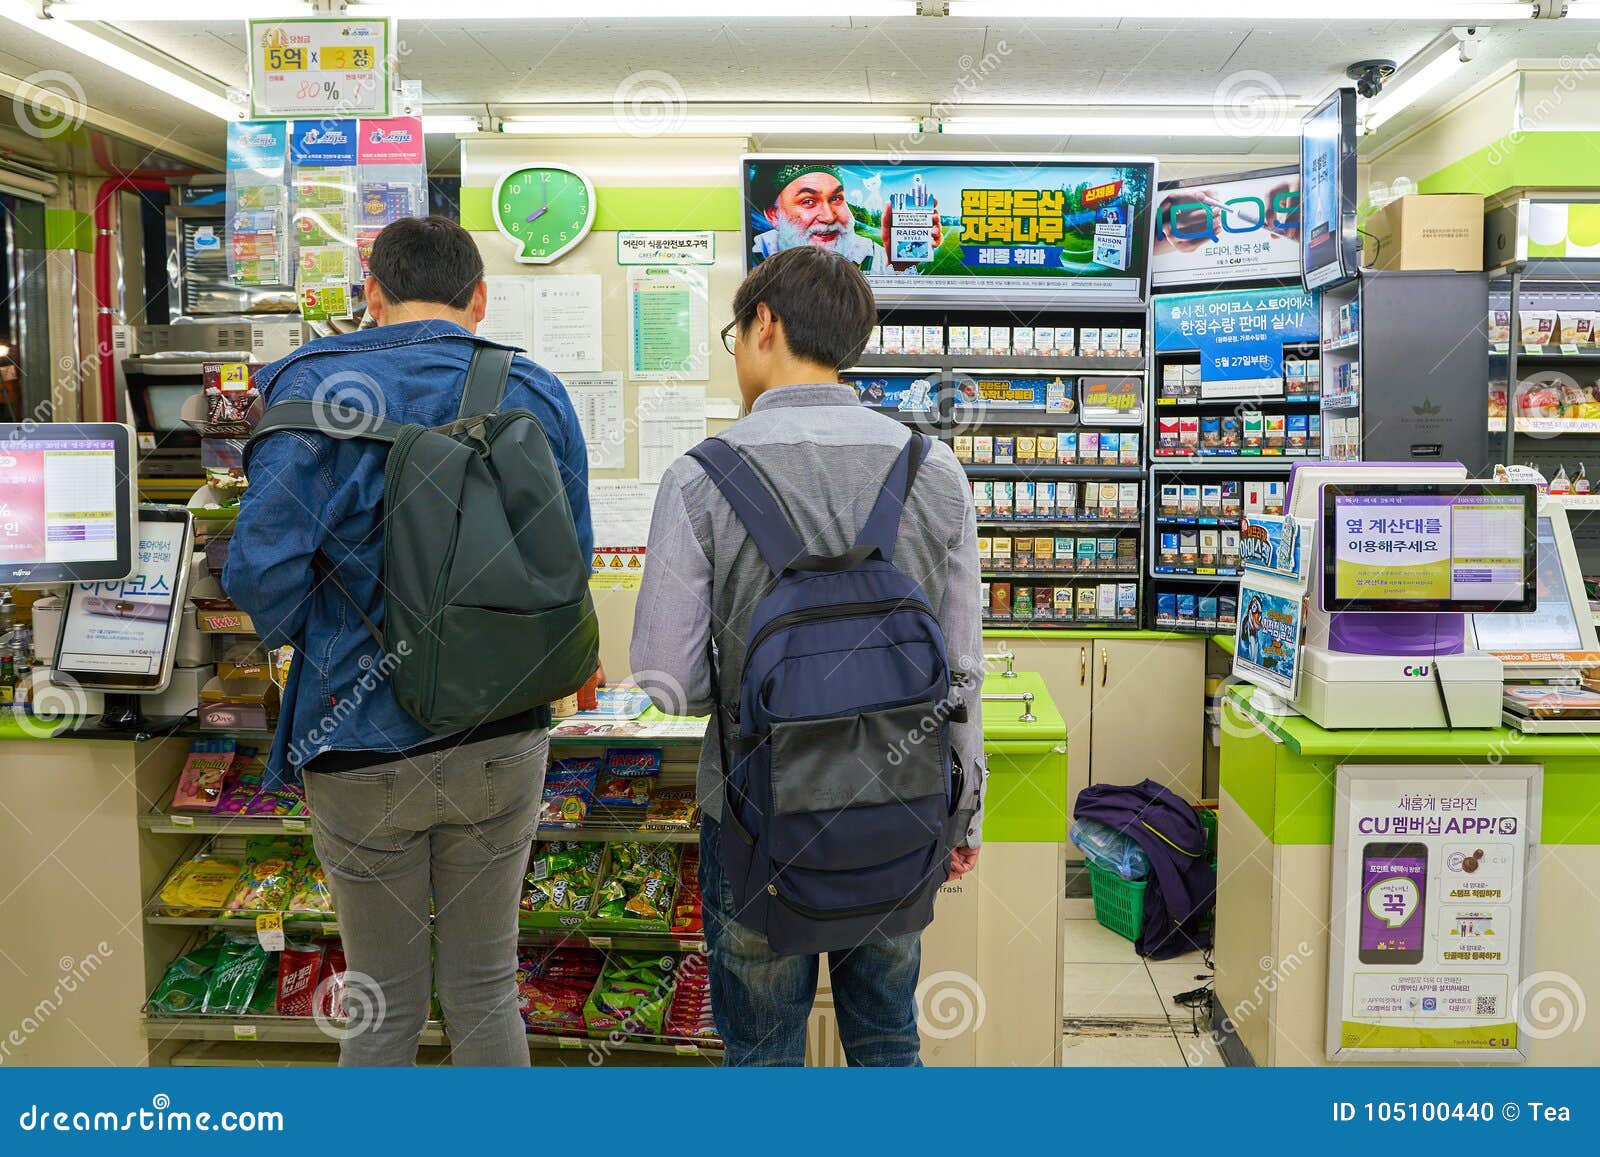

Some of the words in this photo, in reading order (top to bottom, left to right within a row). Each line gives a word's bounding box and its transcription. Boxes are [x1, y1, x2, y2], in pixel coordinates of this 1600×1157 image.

[270, 49, 302, 69] 5억
[352, 49, 369, 67] 장
[524, 174, 531, 184] 11
[540, 172, 551, 182] 12
[563, 175, 568, 183] 1
[509, 185, 521, 194] 10
[578, 186, 585, 195] 2
[504, 203, 511, 213] 9
[580, 206, 586, 215] 3
[512, 223, 519, 233] 8
[572, 221, 579, 230] 4
[961, 216, 1064, 243] 자작나무
[527, 231, 534, 241] 7
[542, 234, 549, 244] 6
[560, 231, 567, 241] 5
[1097, 236, 1122, 245] RAISON
[623, 240, 646, 248] 어린이
[648, 239, 708, 249] 식품안전보호구역
[1204, 247, 1232, 257] 드디어,
[1234, 244, 1251, 256] 한국
[978, 248, 1010, 265] 레종
[1013, 248, 1045, 265] 휘바
[305, 289, 316, 307] 5
[1171, 305, 1192, 319] 출시
[1208, 301, 1254, 316] 아이코스
[1255, 296, 1314, 312] 스토어에서
[1180, 314, 1236, 336] 한정수량
[1238, 313, 1267, 332] 판매
[1270, 311, 1305, 330] 실시!
[1214, 357, 1230, 368] 5월
[226, 365, 244, 381] 2+1
[1346, 518, 1363, 534] 옆
[1369, 518, 1443, 534] 계산대를
[138, 540, 172, 549] 토어에서
[1349, 540, 1438, 553] 이용해주세요
[208, 712, 235, 724] Dove
[609, 754, 654, 767] HARIBO
[1398, 796, 1436, 811] 새롭게
[1440, 796, 1477, 811] 달라진
[1444, 816, 1497, 834] APP!
[939, 885, 963, 893] Trash
[1382, 893, 1406, 916] 꾹
